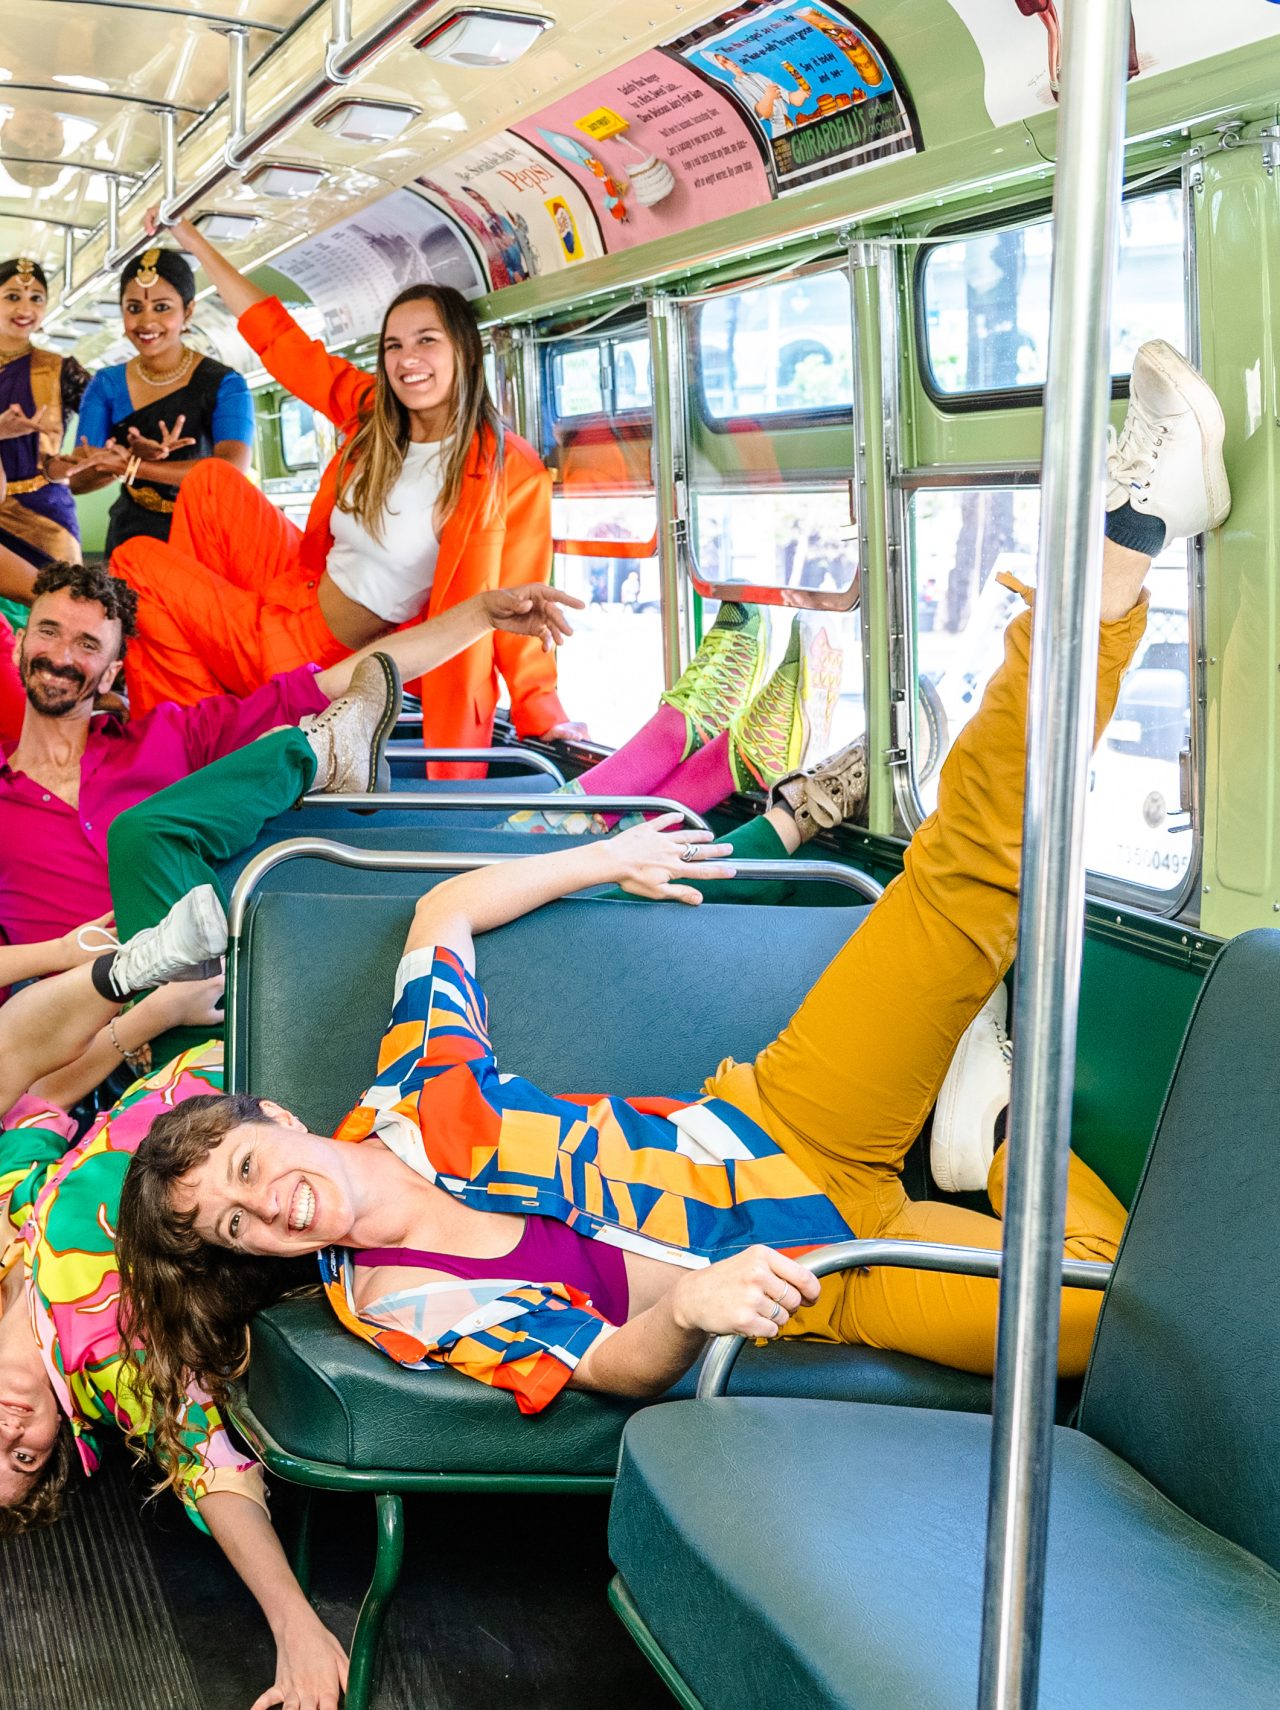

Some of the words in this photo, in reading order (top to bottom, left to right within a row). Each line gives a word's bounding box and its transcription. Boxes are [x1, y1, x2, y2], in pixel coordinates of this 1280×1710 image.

[799, 63, 816, 73] Say
[816, 52, 838, 63] today
[818, 70, 830, 83] and
[791, 106, 866, 165] GHIRARDELLI'S
[496, 158, 554, 194] Pepsi
